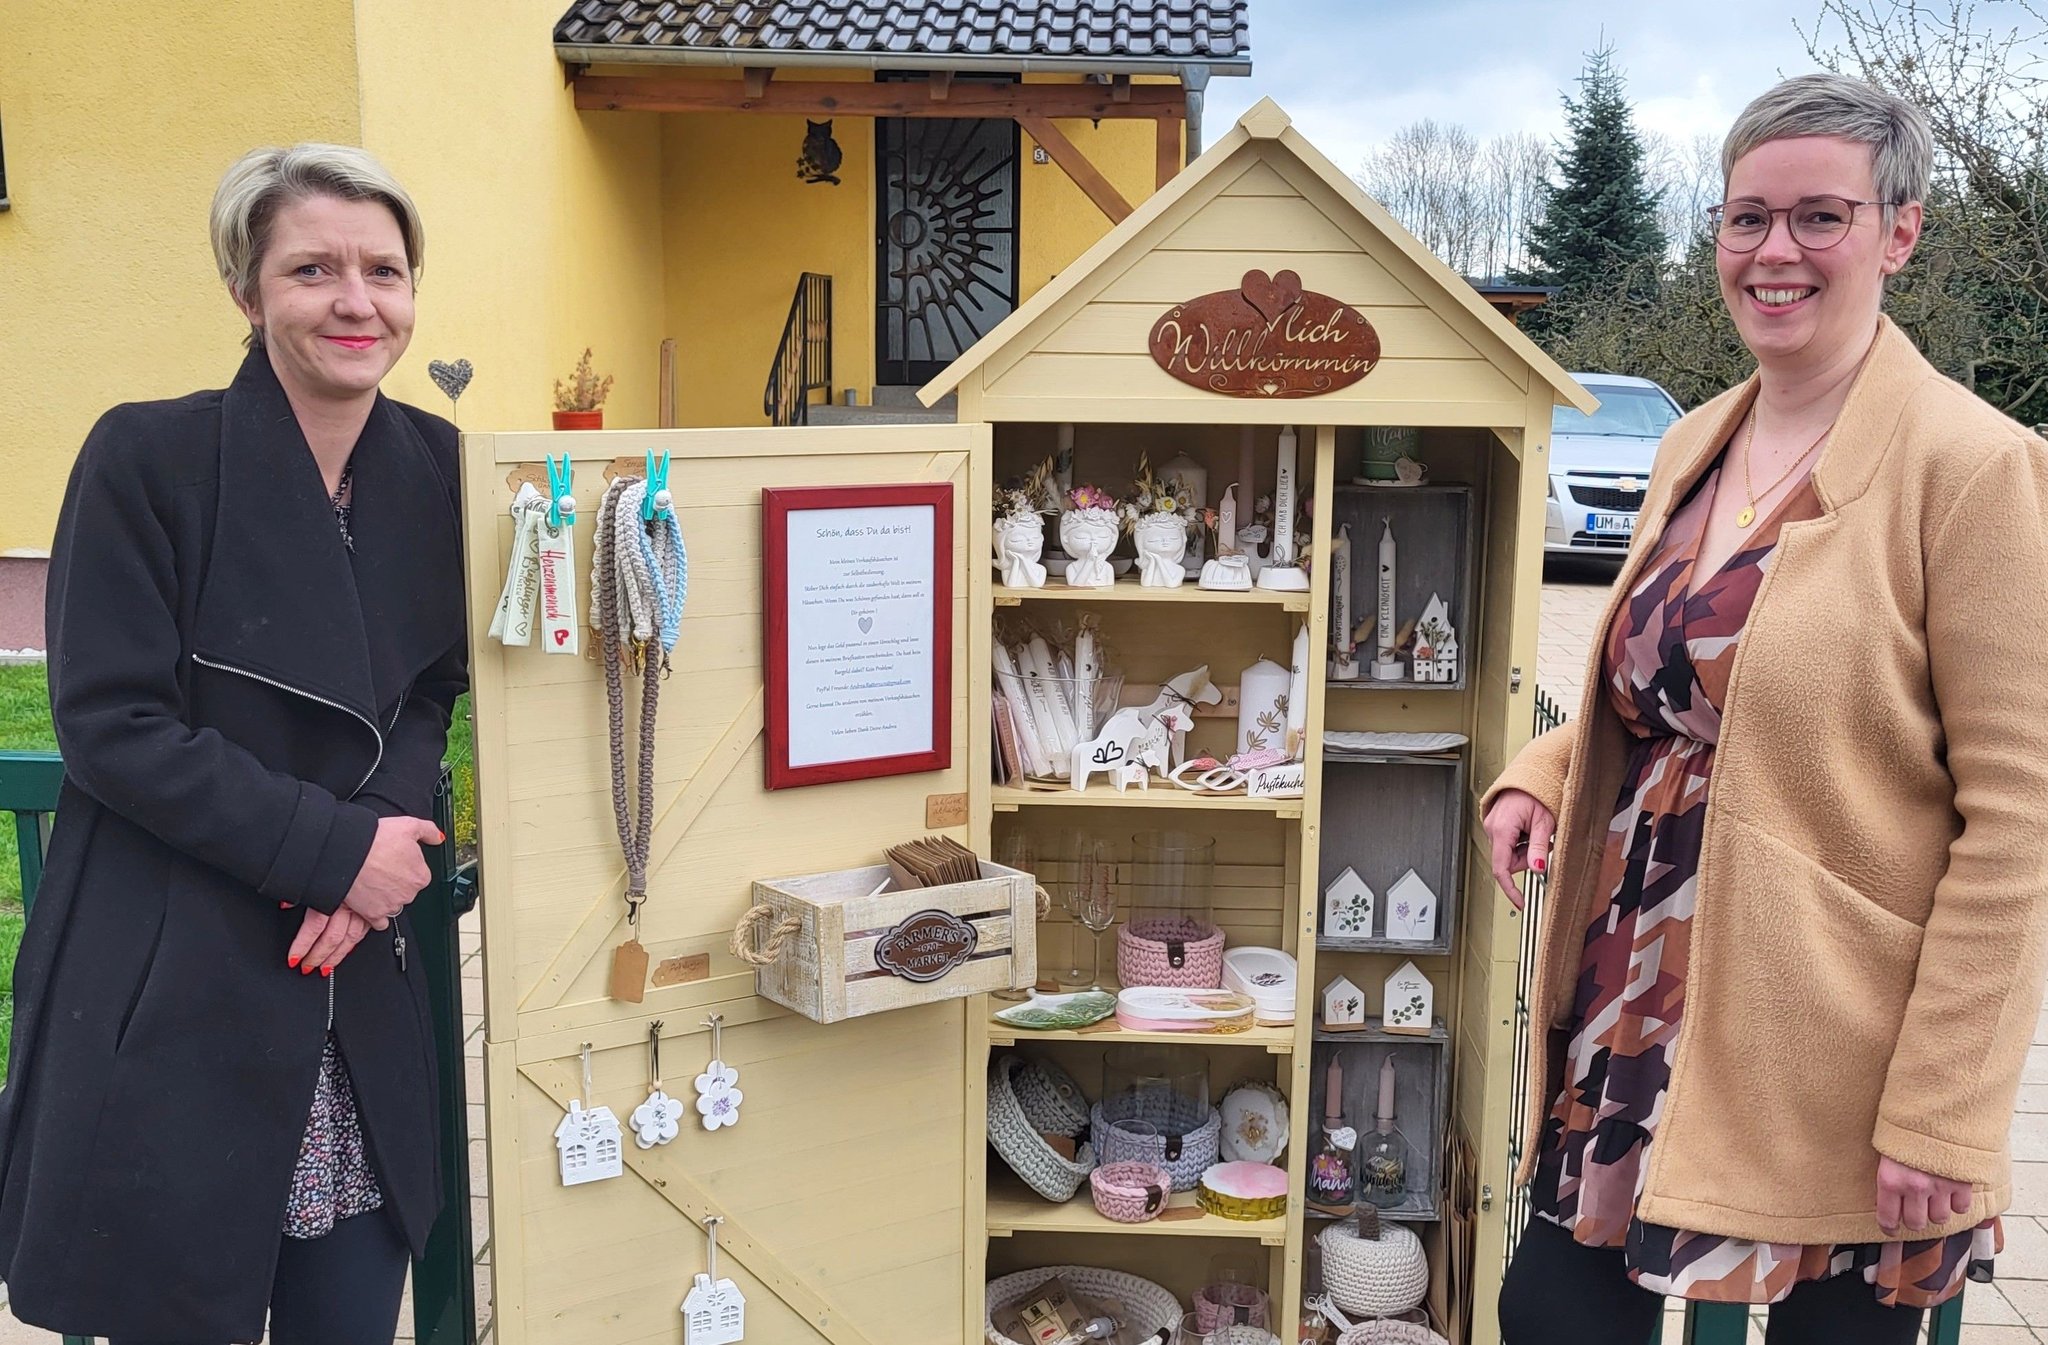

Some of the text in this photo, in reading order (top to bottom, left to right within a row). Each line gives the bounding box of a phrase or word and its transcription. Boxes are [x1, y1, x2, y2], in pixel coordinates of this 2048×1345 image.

[1596, 516, 1613, 529] UM
[816, 525, 911, 538] Schön, dass Du da bist!
[540, 550, 570, 620] Herzensmensch
[896, 925, 958, 952] FARMER'S
[906, 952, 950, 968] MARKET
